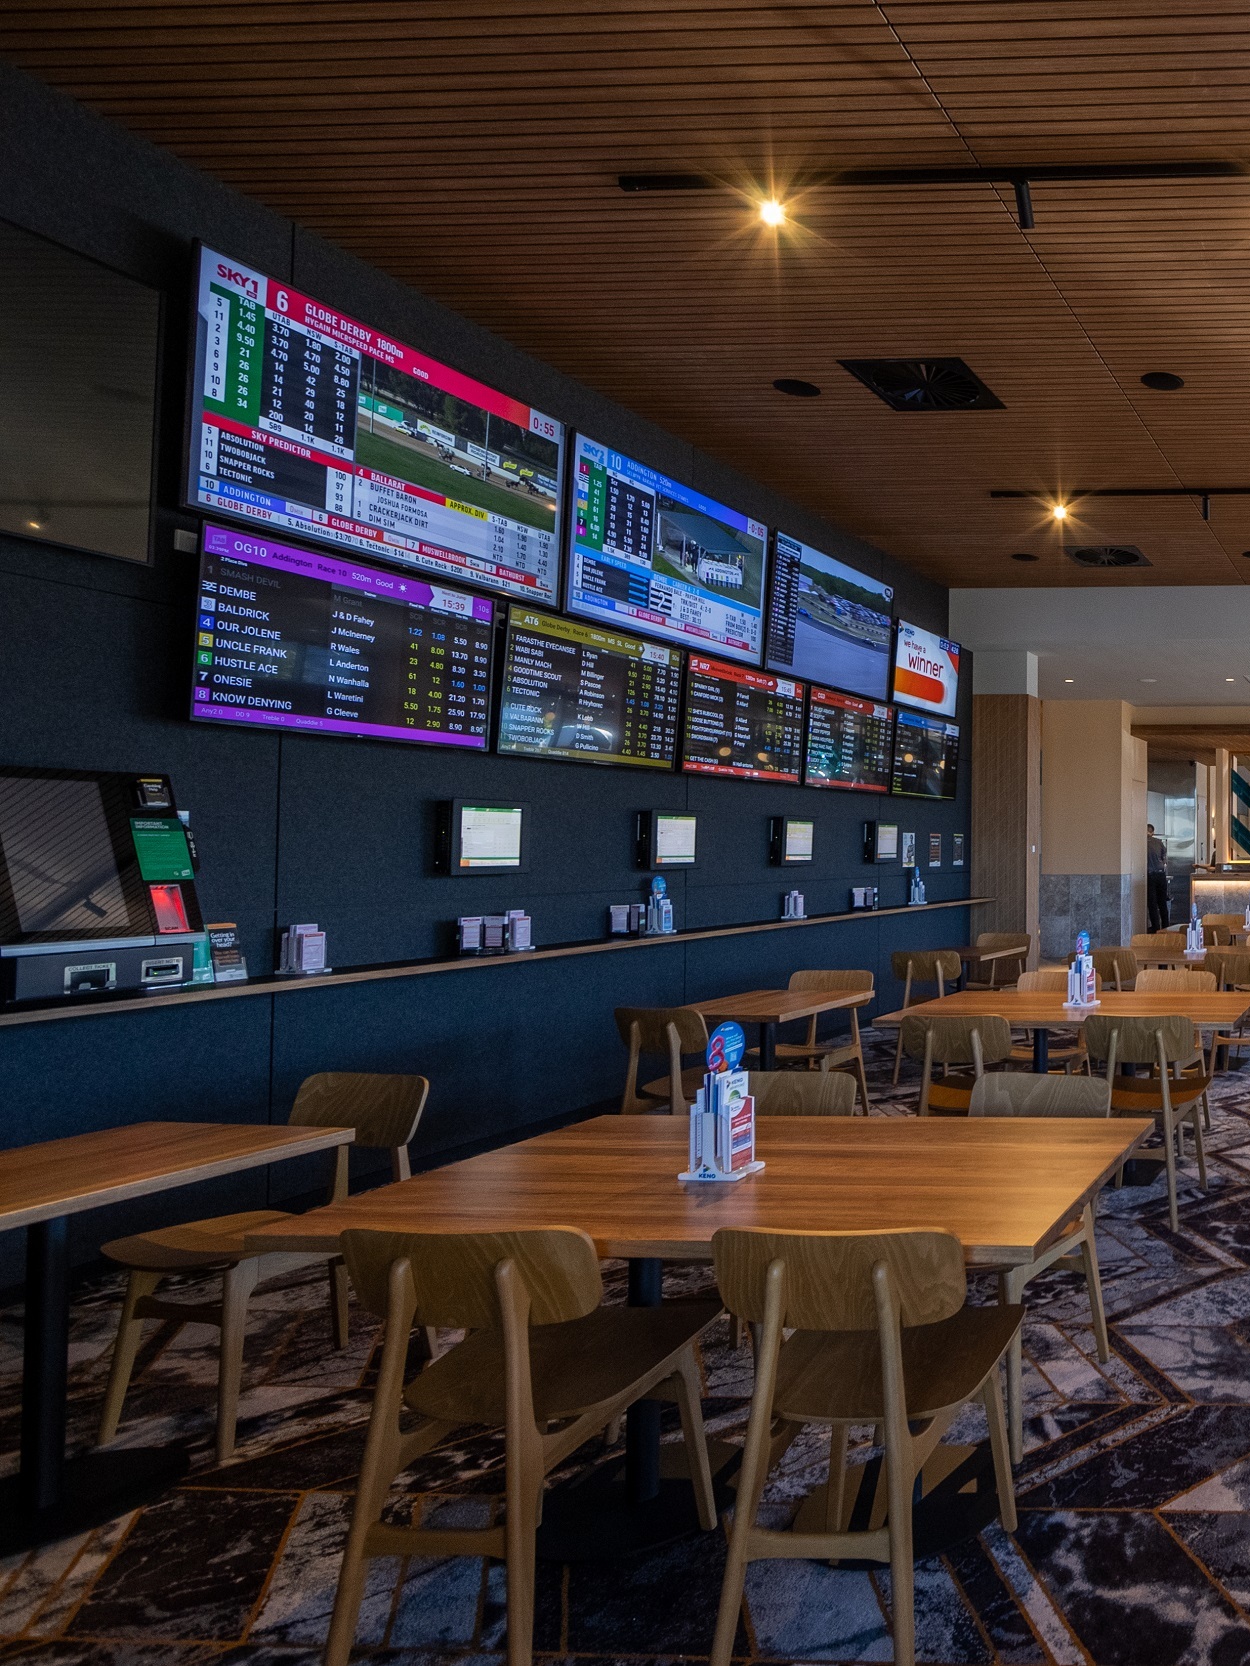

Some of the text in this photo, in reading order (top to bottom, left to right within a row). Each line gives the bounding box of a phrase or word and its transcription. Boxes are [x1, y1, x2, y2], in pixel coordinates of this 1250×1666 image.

[217, 262, 258, 294] SKY1
[238, 295, 255, 311] TAB
[272, 311, 290, 327] UTAB
[306, 328, 321, 341] NSW
[276, 288, 403, 359] 6 GLOBE DERBY 1800m
[216, 297, 350, 365] 5 1.45 3.70 1.80 2.00
[305, 315, 330, 334] HYGAIN
[369, 345, 384, 359] PACE
[385, 353, 394, 364] MS
[214, 309, 350, 377] 11 4.40 3.70 4.70 4.50
[215, 323, 349, 388] 2 9.50 4.70 5.00 8.80
[412, 366, 428, 380] GOOD
[533, 417, 554, 436] 0:55
[220, 431, 263, 452] ABSOLUTION
[251, 430, 310, 458] SKY PREDICTOR
[220, 443, 265, 465] TWOBOBJACK
[219, 454, 274, 479] SNAPPER ROCKS
[219, 466, 252, 484] TECTONIC
[610, 453, 621, 470] 10
[627, 460, 656, 481] ADDINGTON
[371, 472, 405, 491] BALLARAT
[223, 485, 270, 506] ADDINGTON
[370, 482, 416, 504] BUFFET BARON
[217, 497, 272, 520] GLOBE DERBY
[368, 503, 427, 528] CRACKERJACK DIRT
[377, 495, 427, 518] JOSHUA FORMOSA
[450, 500, 484, 518] APPROX. DIV
[331, 518, 377, 538] GLOBE DERBY
[368, 514, 394, 528] DIM SIM
[234, 540, 266, 557] OG10
[272, 551, 312, 569] Addington
[317, 563, 336, 574] Race
[351, 572, 371, 583] 520m
[219, 584, 256, 601] DEMBE
[376, 578, 393, 589] Good
[218, 602, 269, 620] BALDRICK
[442, 598, 464, 611] 15:39
[216, 620, 280, 640] OUR JOLENE
[353, 615, 374, 627] Fahey
[524, 615, 538, 626] AT6
[215, 638, 287, 658] UNCLE FRANK
[337, 644, 359, 654] Wales
[451, 651, 468, 660] 13.70
[649, 651, 664, 661] 15:40
[904, 640, 911, 648] we
[912, 642, 922, 652] have
[214, 656, 278, 674] HUSTLE ACE
[336, 660, 368, 672] Anderton
[908, 652, 944, 678] winner
[213, 673, 252, 687] ONESIE
[212, 692, 291, 710] KNOW DENYING
